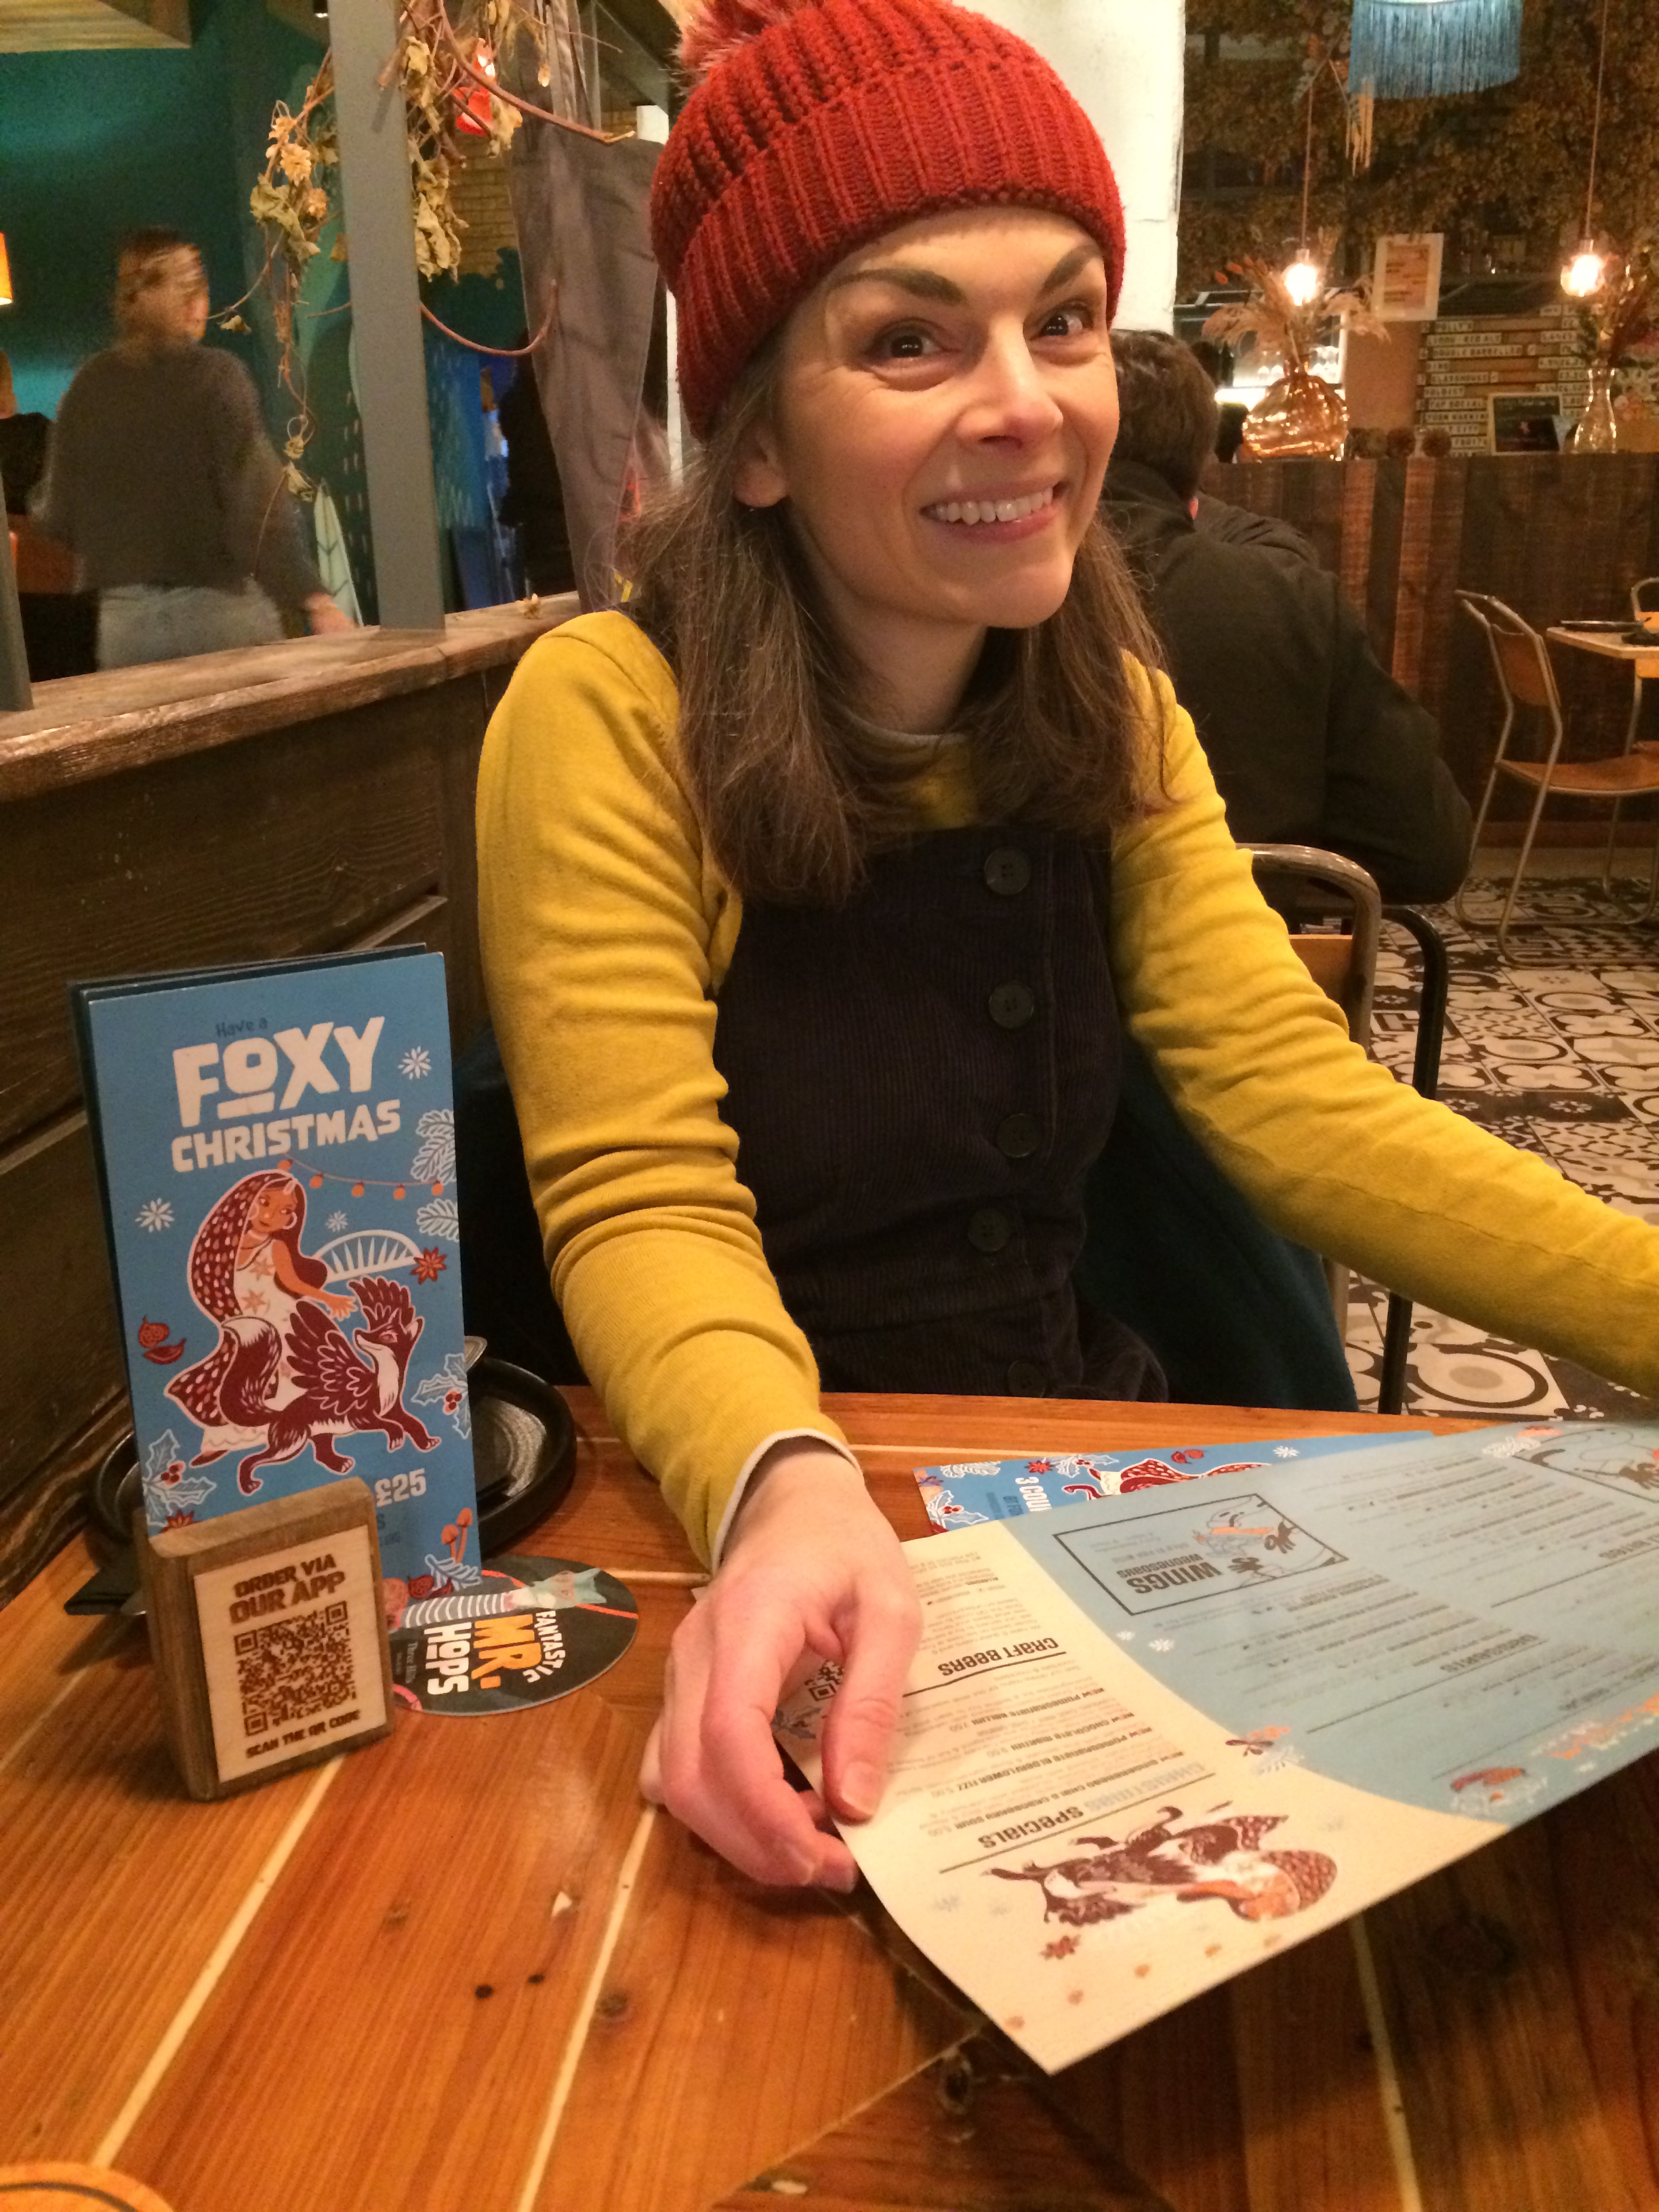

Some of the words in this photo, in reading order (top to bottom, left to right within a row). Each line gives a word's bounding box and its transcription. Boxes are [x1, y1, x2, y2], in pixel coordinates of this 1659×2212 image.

[215, 1019, 254, 1038] Have
[258, 1016, 267, 1029] a
[173, 1017, 385, 1128] FOXY
[171, 1099, 401, 1172] CHRISTMAS
[375, 1468, 426, 1507] £25
[229, 1589, 293, 1625] OUR
[291, 1571, 346, 1610] APP
[233, 1565, 297, 1599] ORDER
[301, 1554, 337, 1577] VIA
[424, 1622, 472, 1695] HOPS
[472, 1614, 541, 1689] MR.
[523, 1610, 565, 1683] FANTASTIC
[244, 1738, 281, 1758] SCAN
[281, 1728, 306, 1745] THE
